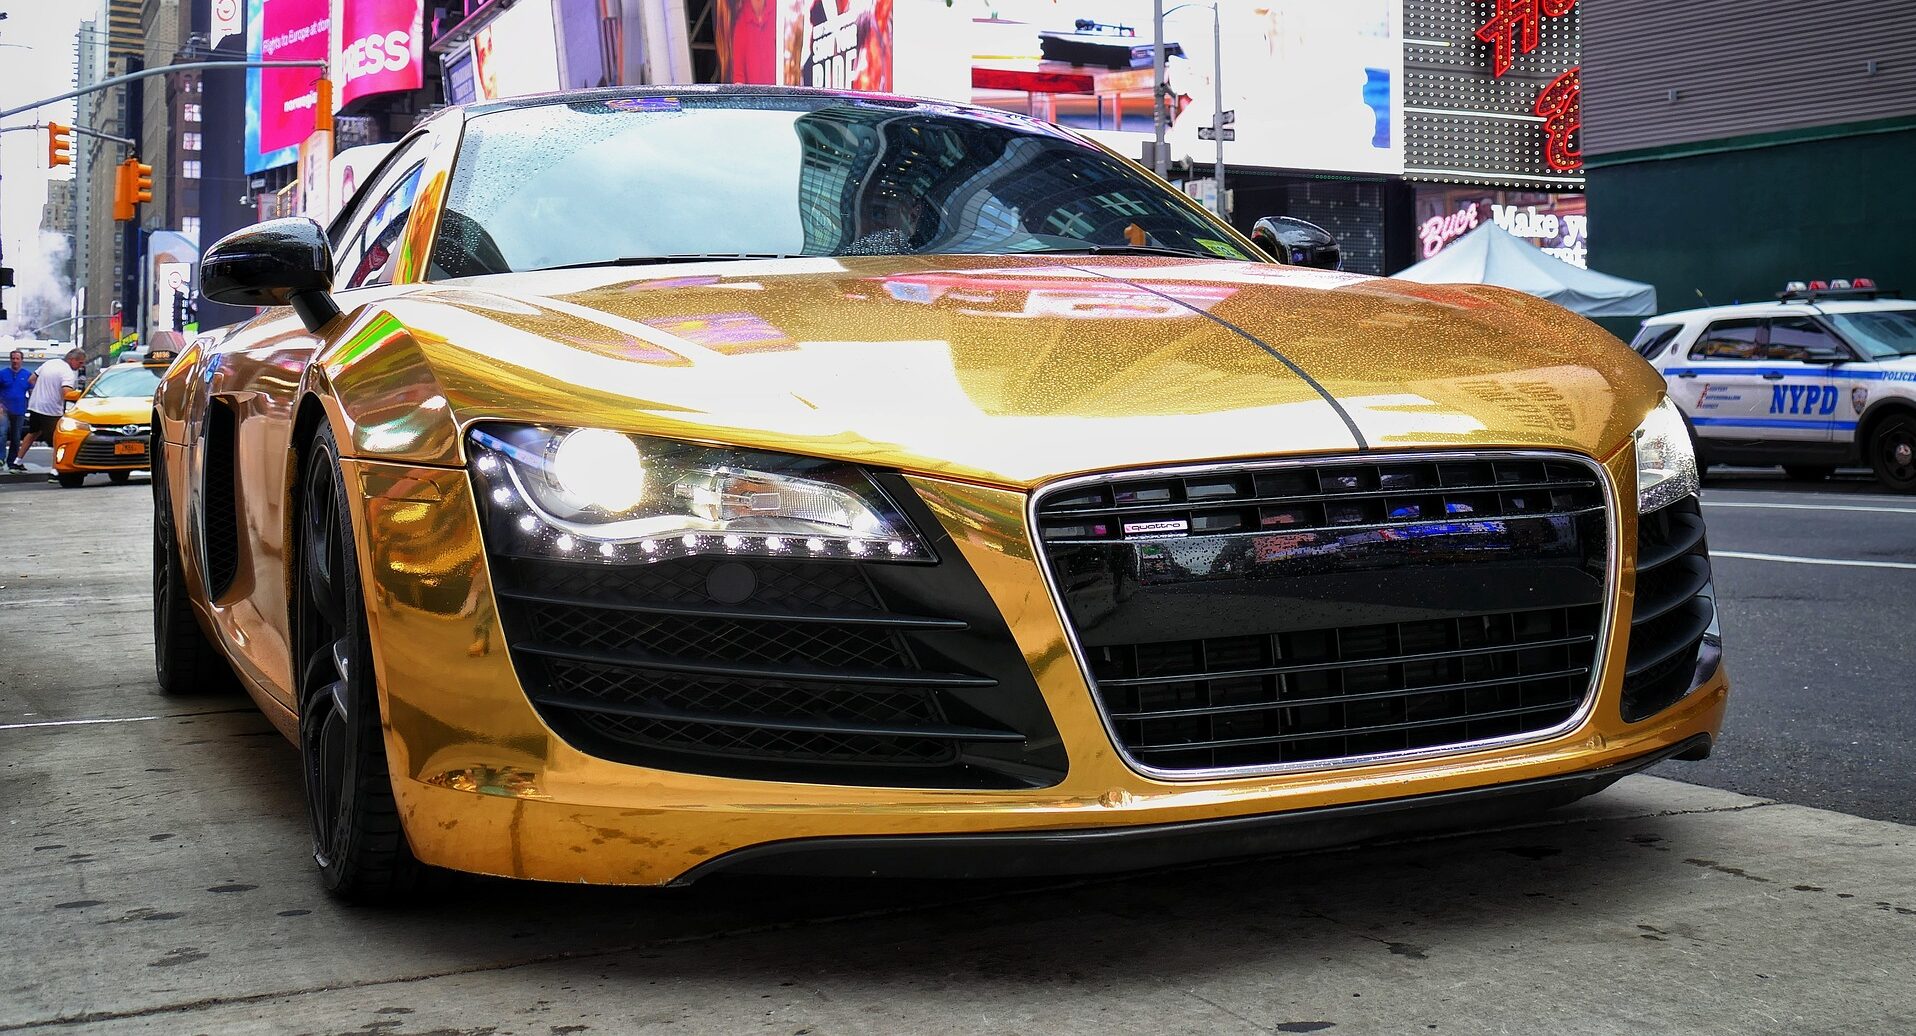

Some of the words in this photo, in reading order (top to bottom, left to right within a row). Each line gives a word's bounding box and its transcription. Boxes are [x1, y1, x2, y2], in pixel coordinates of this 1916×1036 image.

[1491, 204, 1559, 239] Make
[1769, 384, 1839, 415] NYPD
[1131, 523, 1180, 531] quattro
